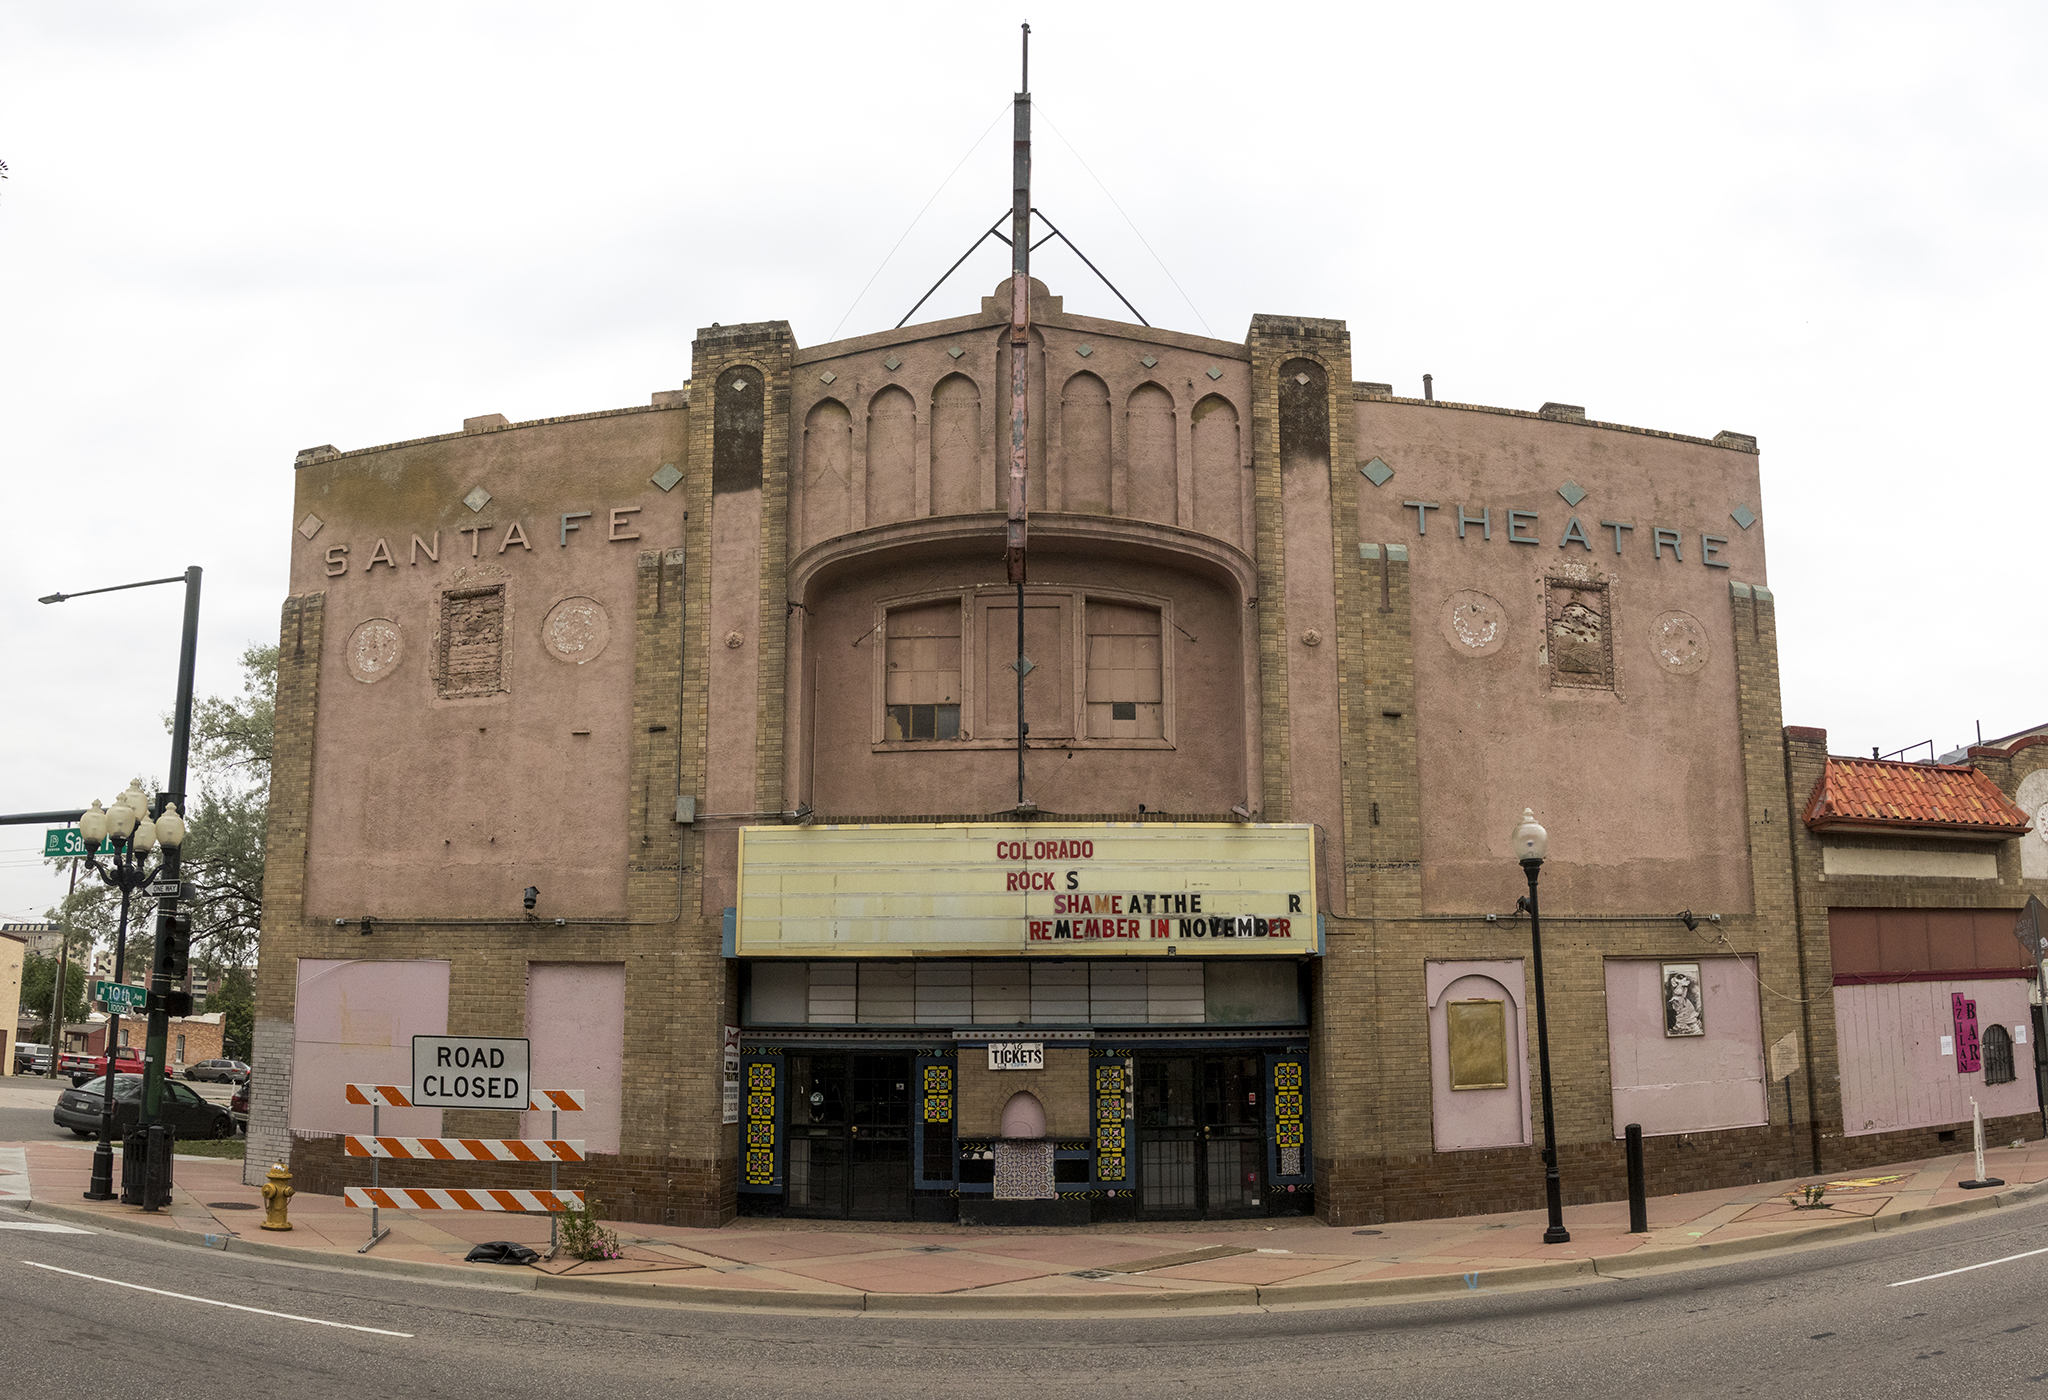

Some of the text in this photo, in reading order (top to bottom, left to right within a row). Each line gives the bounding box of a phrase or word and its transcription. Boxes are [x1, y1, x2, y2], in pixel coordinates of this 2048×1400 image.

[324, 506, 641, 577] SANTA FE
[1403, 500, 1730, 568] THEATRE
[996, 840, 1094, 860] COLORADO
[1006, 871, 1056, 891] ROCK
[1054, 894, 1123, 914] SHAME
[1288, 894, 1302, 912] R
[1029, 916, 1291, 940] REMEMBER IN NOVEMBER
[109, 986, 130, 1002] 10th
[133, 993, 143, 1001] Ave
[1955, 995, 1968, 1072] AZTLAN
[1966, 1003, 1980, 1061] BAR
[437, 1046, 504, 1068] ROAD
[992, 1049, 1042, 1064] TICKETS
[423, 1075, 519, 1098] CLOSED
